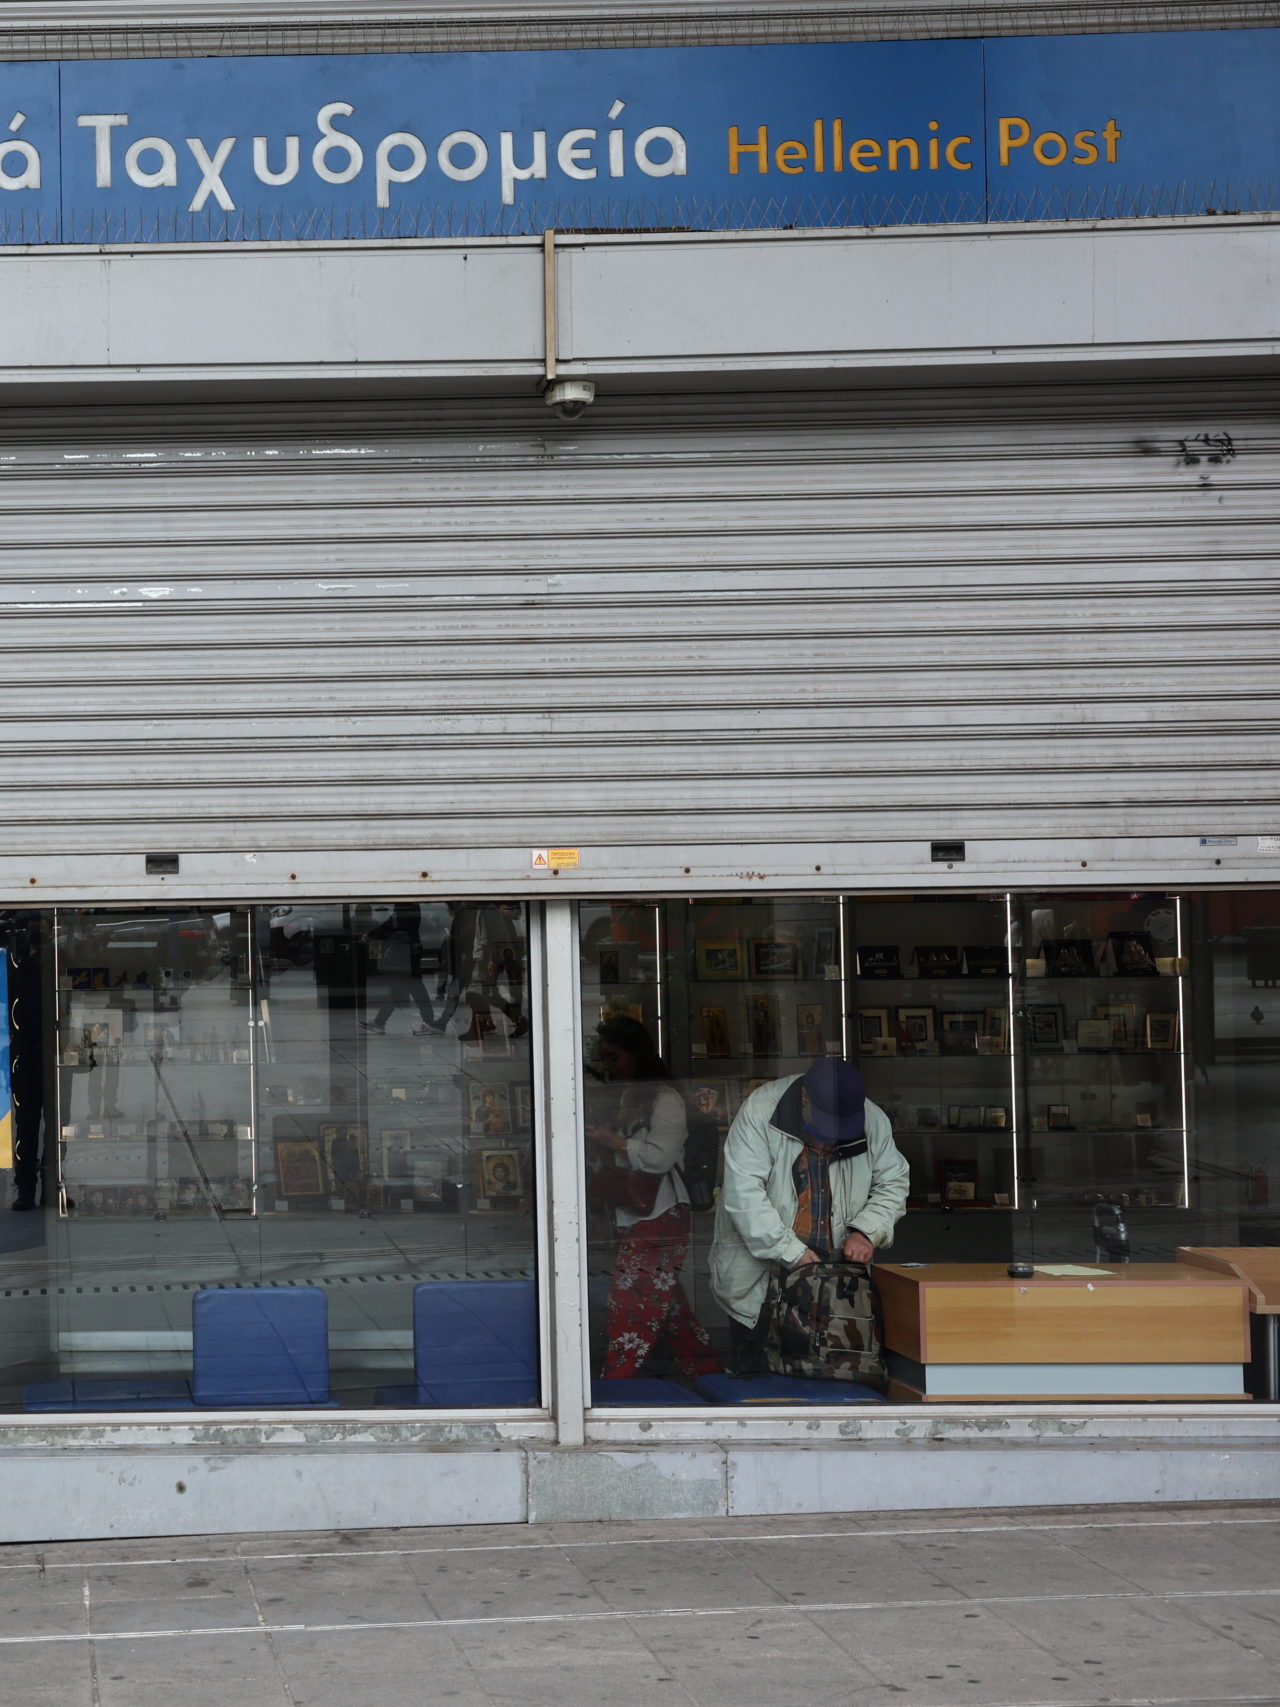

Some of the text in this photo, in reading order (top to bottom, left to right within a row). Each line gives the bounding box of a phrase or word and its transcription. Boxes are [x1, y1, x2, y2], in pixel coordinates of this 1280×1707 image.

[77, 99, 687, 212] Ταχυδρομεία
[728, 116, 1122, 174] Hellenic Post
